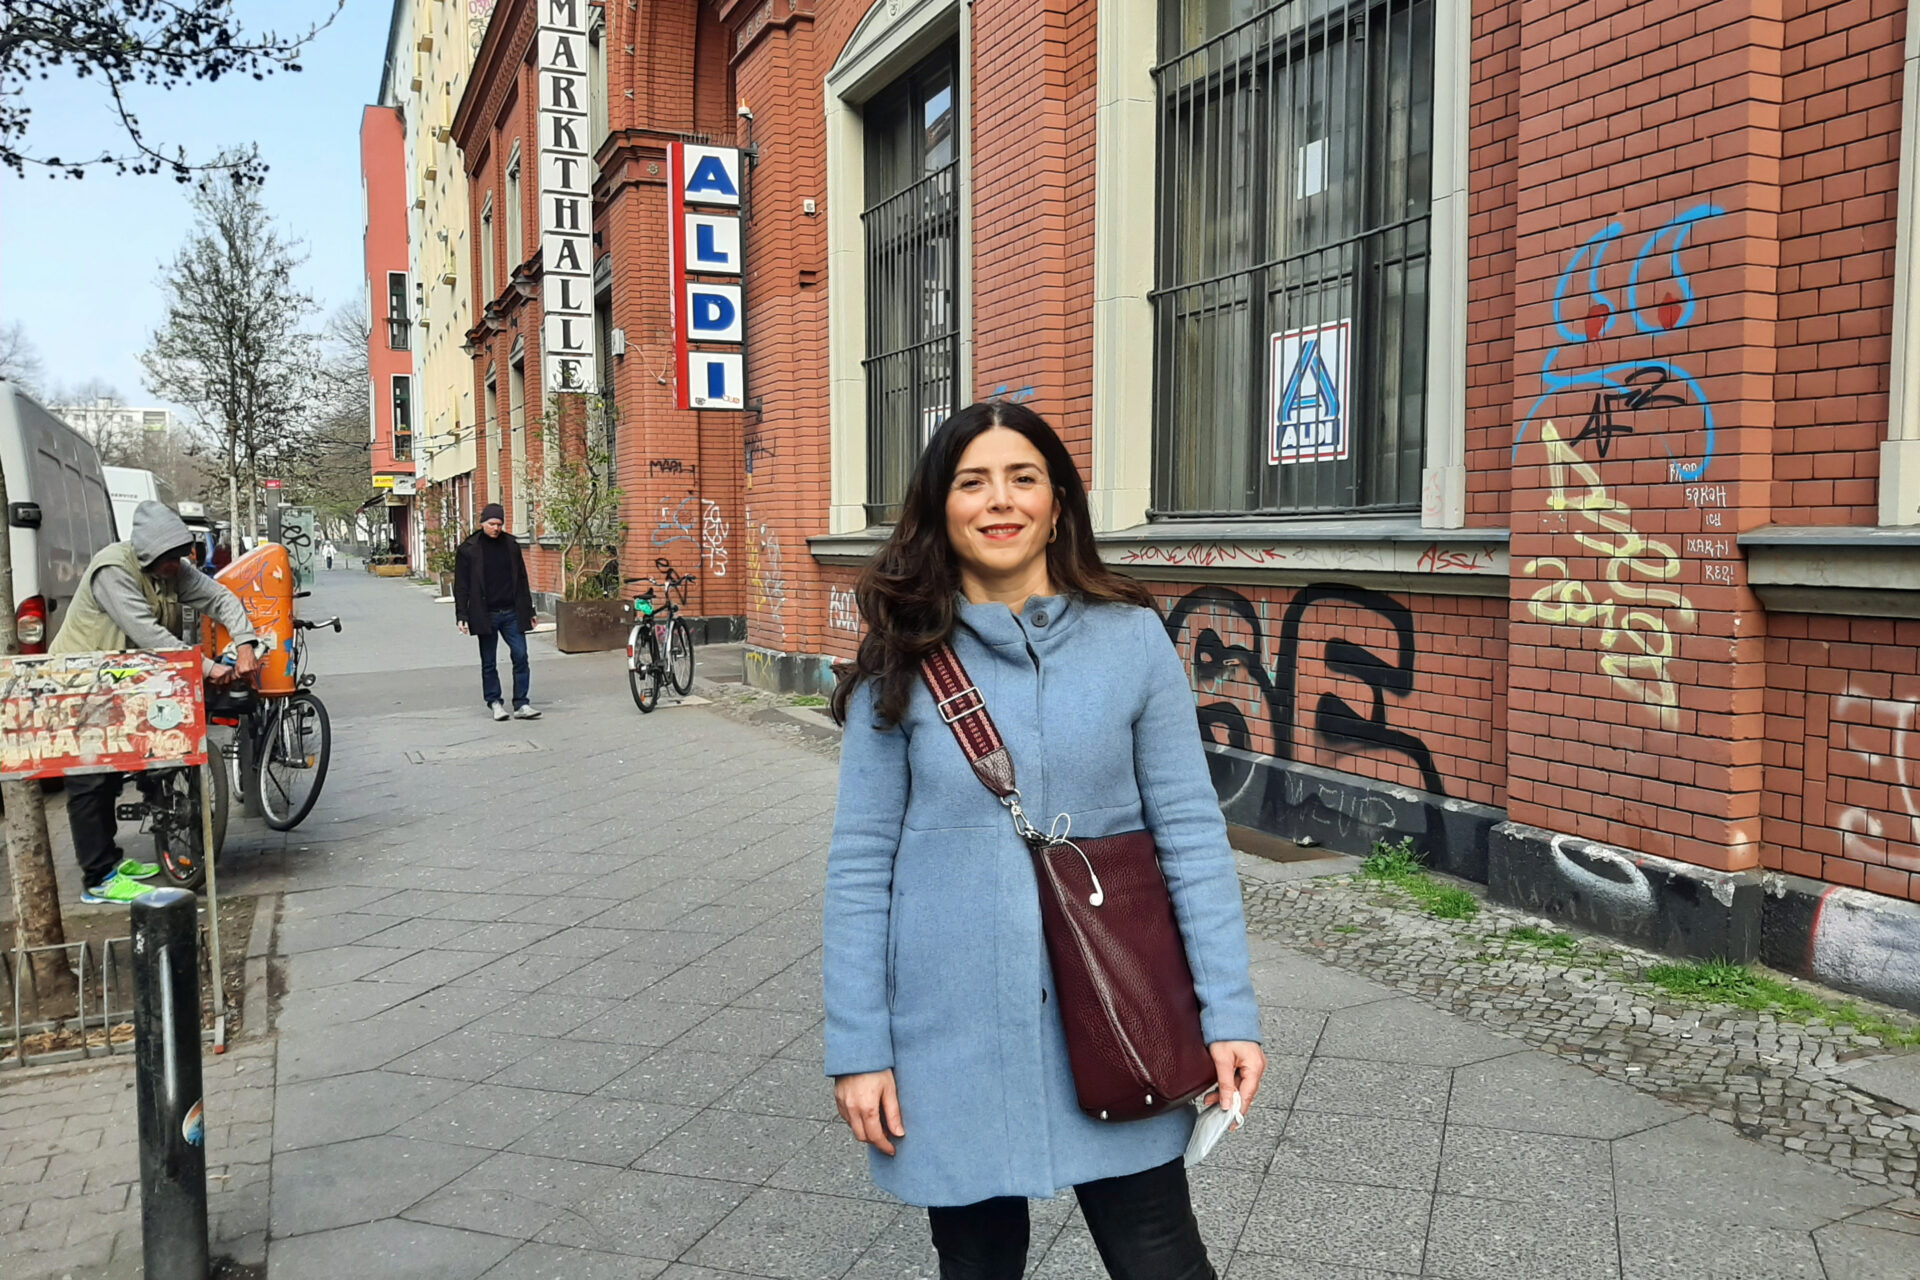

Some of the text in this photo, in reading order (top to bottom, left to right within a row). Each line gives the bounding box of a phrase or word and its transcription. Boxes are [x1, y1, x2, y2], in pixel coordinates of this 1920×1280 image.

[548, 0, 586, 390] MARKTHALLE
[686, 156, 738, 399] ALDI
[1281, 420, 1333, 448] ALDI
